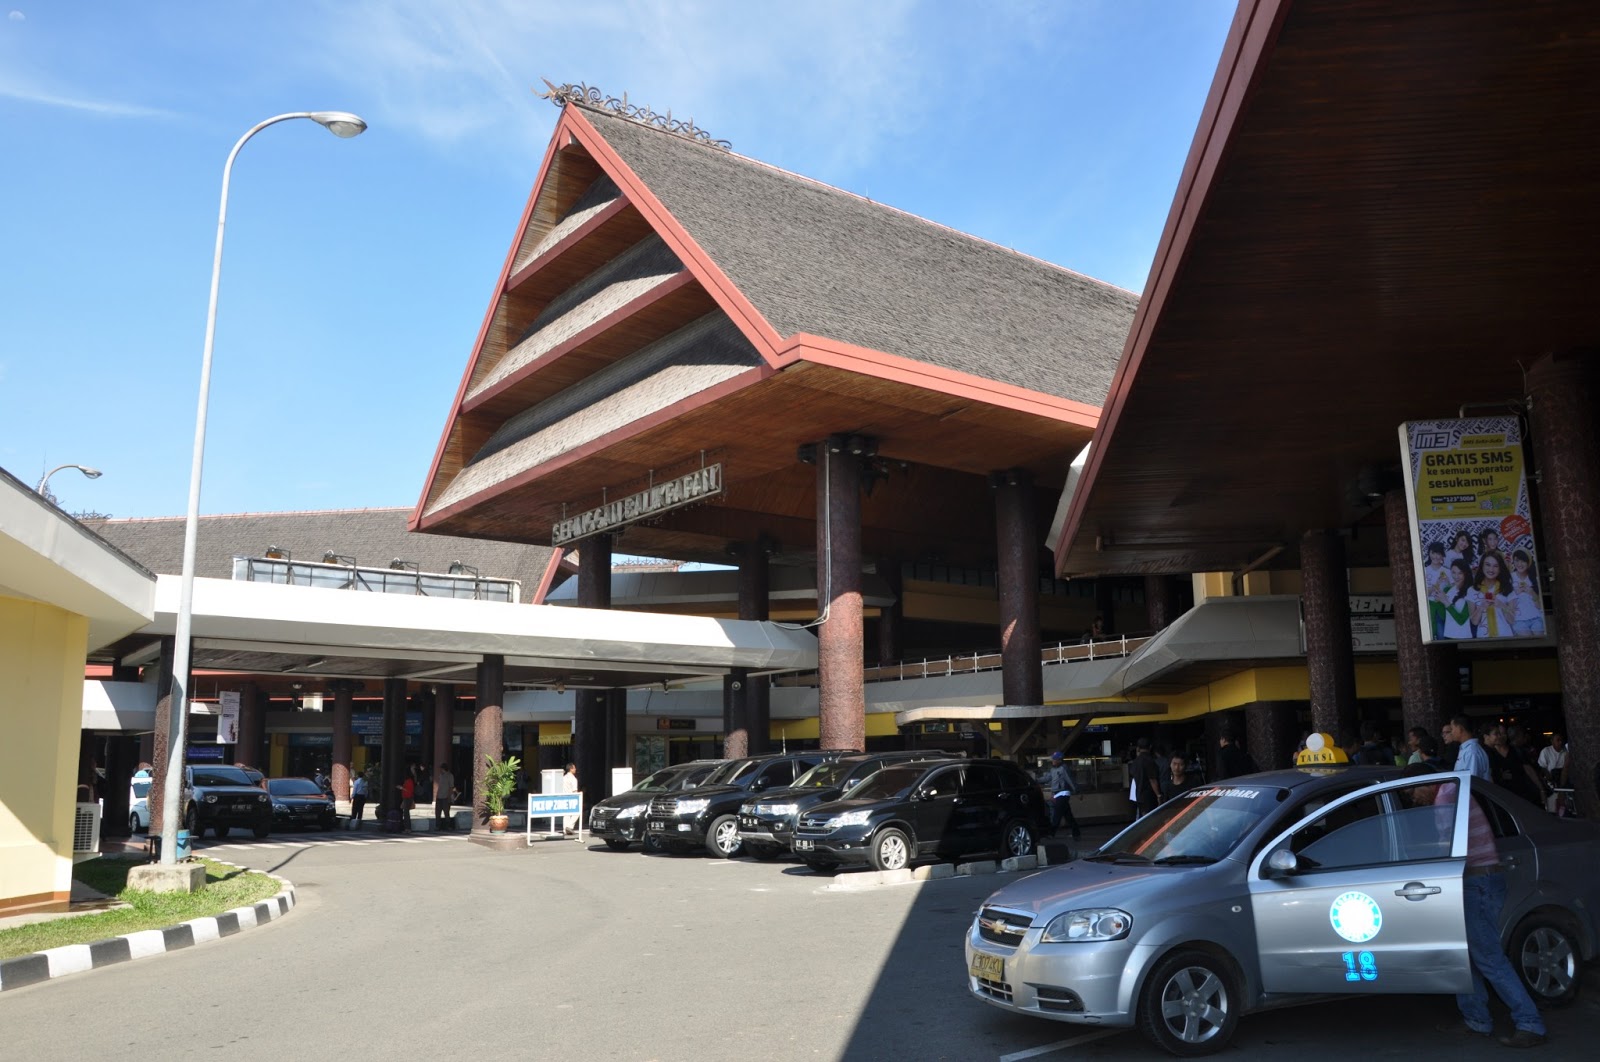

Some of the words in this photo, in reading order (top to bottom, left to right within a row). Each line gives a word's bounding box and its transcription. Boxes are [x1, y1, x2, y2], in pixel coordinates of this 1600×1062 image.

[1415, 432, 1450, 449] IM3
[1426, 453, 1478, 467] GRATIS
[1481, 451, 1513, 464] SMS
[1427, 467, 1438, 476] ke
[1440, 467, 1471, 476] semua
[1473, 465, 1514, 475] operator
[1428, 475, 1494, 489] sesukamu!
[1300, 753, 1332, 763] TAKSI
[1342, 950, 1378, 981] 18
